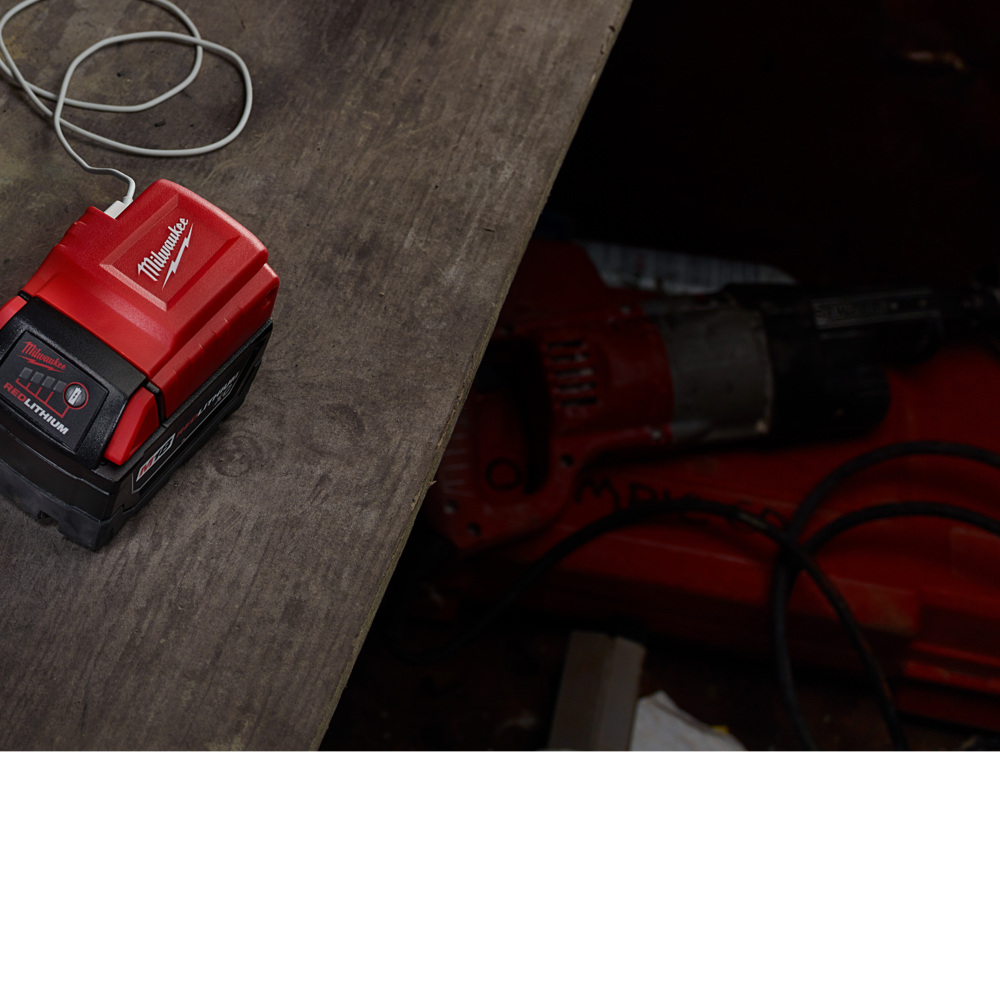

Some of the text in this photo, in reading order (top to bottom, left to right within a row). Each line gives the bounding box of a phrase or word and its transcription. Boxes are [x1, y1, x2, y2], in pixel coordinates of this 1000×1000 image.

[138, 218, 189, 281] Milwaukee
[22, 341, 67, 370] Milwaukee
[3, 382, 70, 435] REDLITHIUM
